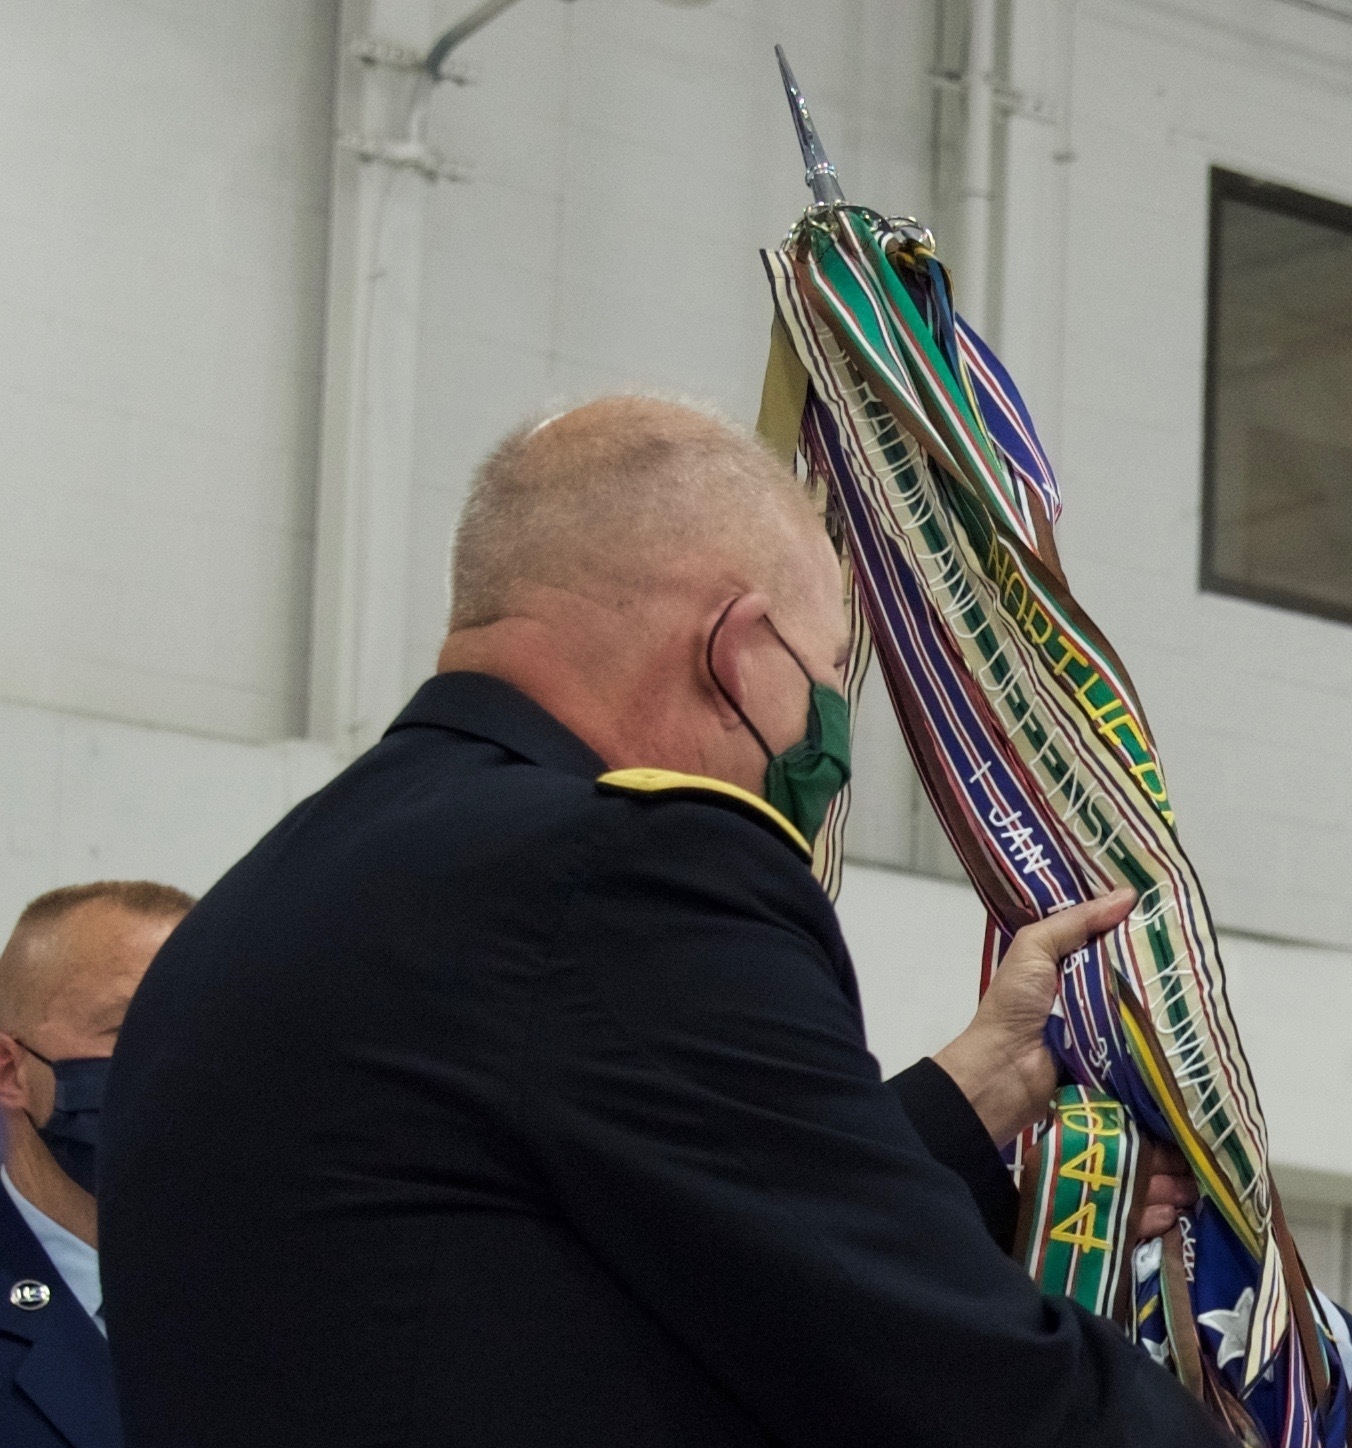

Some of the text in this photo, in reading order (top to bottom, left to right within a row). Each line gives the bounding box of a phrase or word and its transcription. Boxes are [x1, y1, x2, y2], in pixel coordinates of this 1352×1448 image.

[917, 542, 993, 638] AND
[978, 637, 1146, 886] DEFENSE
[988, 811, 1052, 875] JAN
[1128, 880, 1183, 933] OF
[1143, 951, 1248, 1151] KUWAIT
